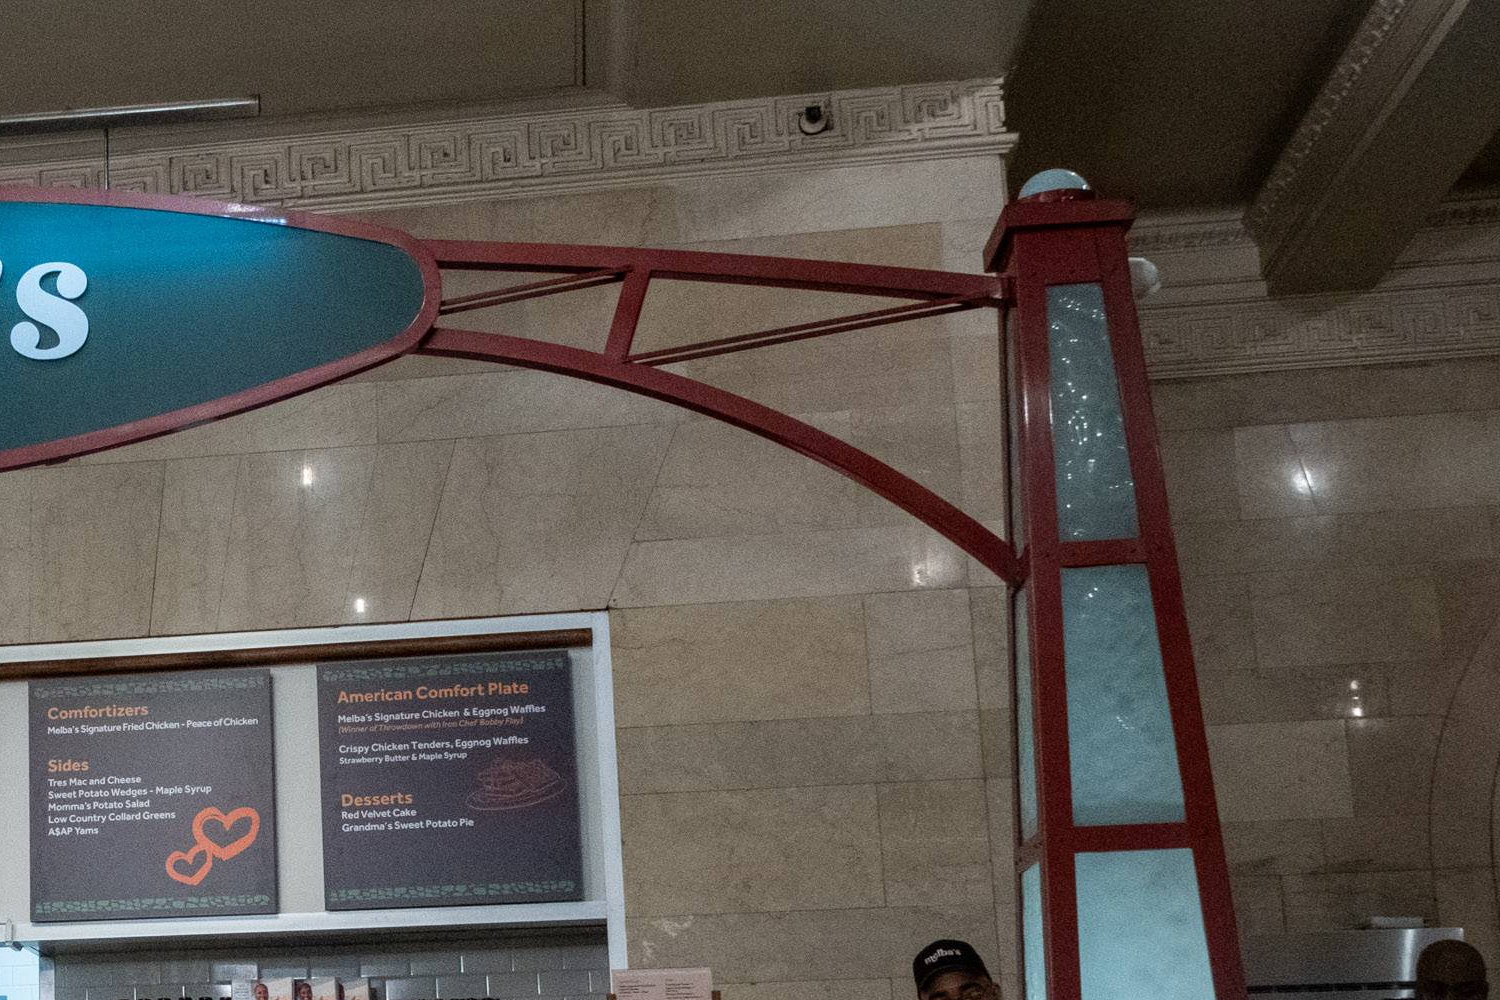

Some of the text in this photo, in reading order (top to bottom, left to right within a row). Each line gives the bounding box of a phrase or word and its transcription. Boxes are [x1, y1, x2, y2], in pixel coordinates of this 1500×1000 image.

[337, 682, 529, 704] American Comfort Plate
[48, 705, 148, 720] Comfortizers
[338, 704, 546, 723] Melba's Signature Chicken & Eggnog Waffles
[48, 726, 79, 735] Melba's
[81, 724, 121, 735] Signature
[123, 722, 144, 731] Fried
[146, 721, 180, 730] Chicken
[187, 719, 211, 728] Peace
[224, 717, 258, 726] Chicken
[339, 736, 528, 754] Crispy Chicken Tenders, Eggnog Waffles
[340, 756, 383, 765] Strawberry
[385, 754, 410, 762] Butter
[419, 752, 442, 761] Maple
[444, 751, 467, 761] Syrup
[48, 760, 88, 772] Sides
[48, 775, 141, 787] Tres Mac and Cheese
[78, 789, 109, 797] Potato
[111, 788, 148, 798] Wedges
[156, 786, 182, 795] Maple
[185, 785, 211, 794] Syrup
[48, 799, 149, 811] Momma's Potato Salad
[341, 792, 413, 807] Desserts
[48, 811, 175, 824] Low Country Collard Greens
[342, 808, 416, 819] Red Velvet Cake
[48, 827, 72, 836] A$AP
[342, 818, 474, 832] Grandma's Sweet Potato Pie
[924, 948, 962, 965] melba's
